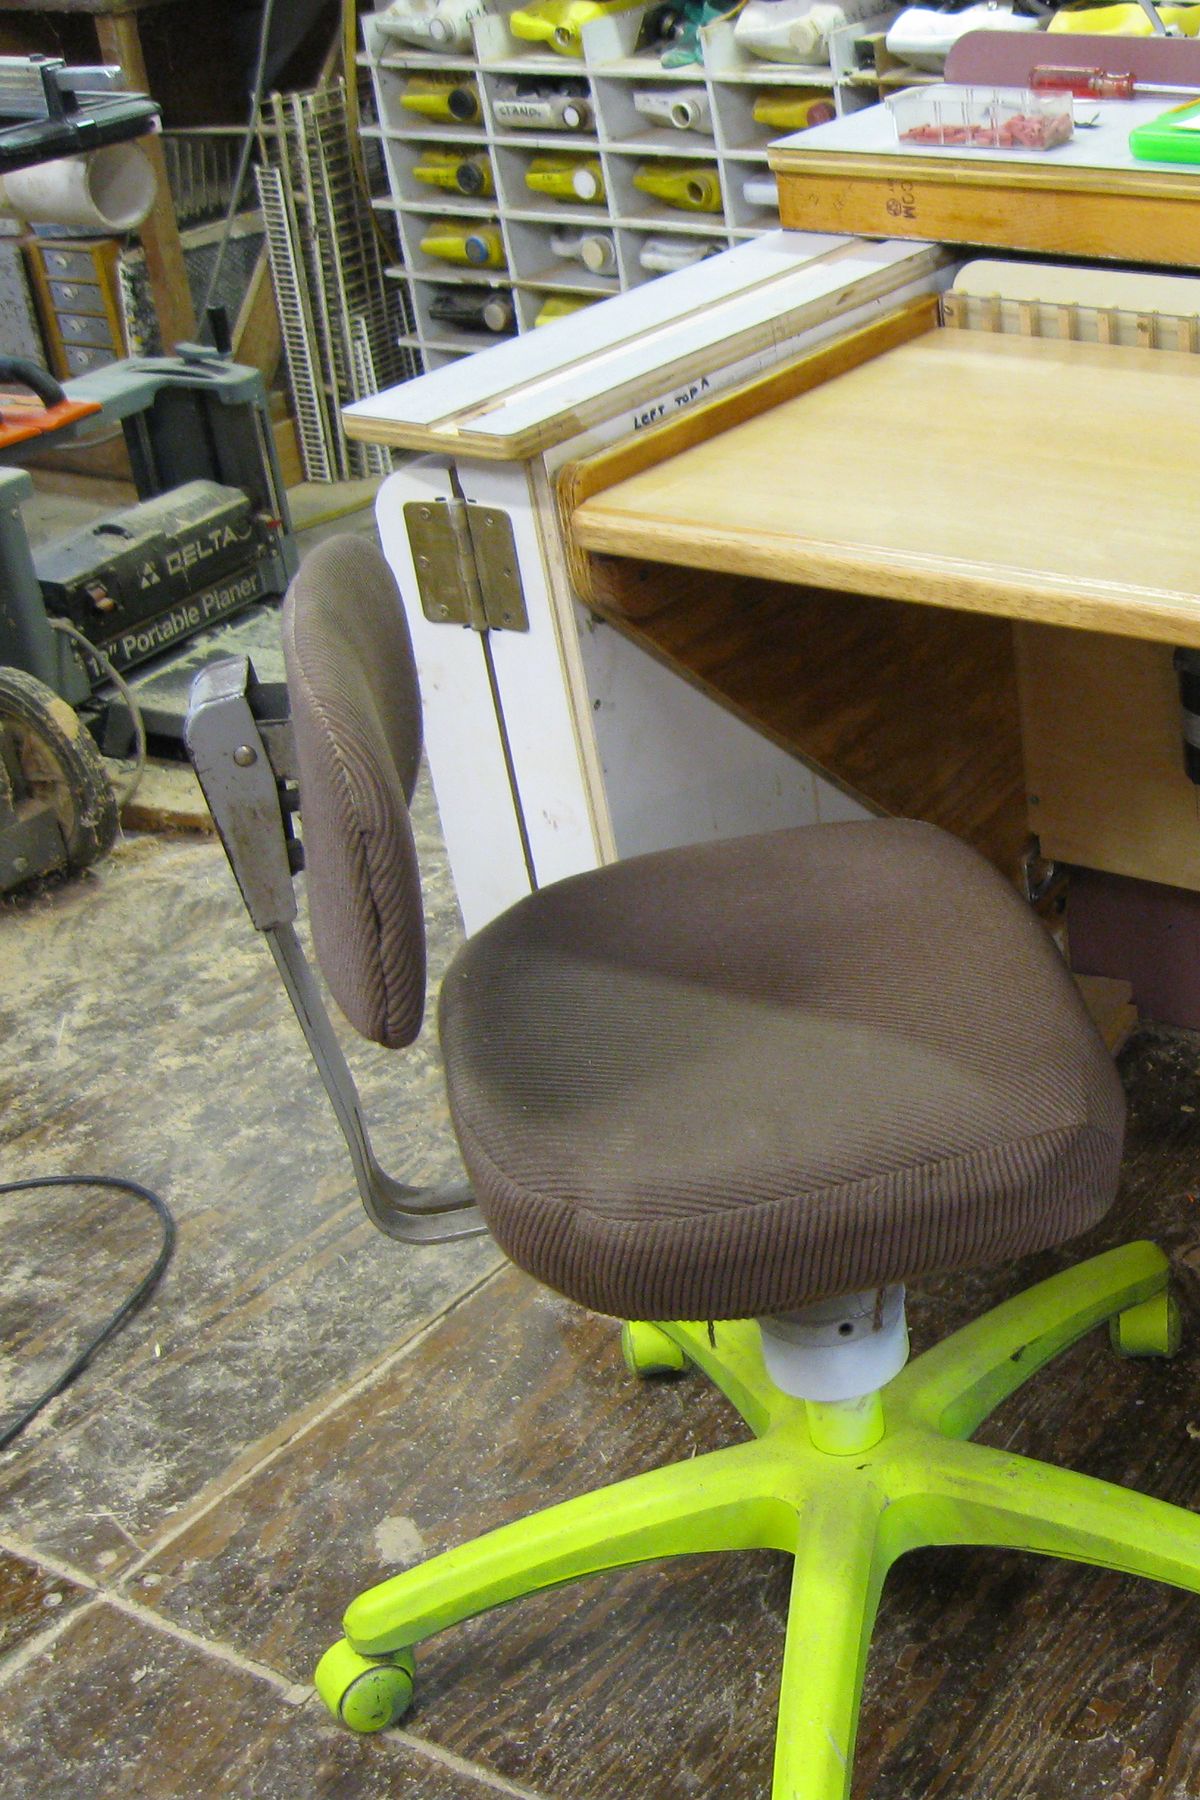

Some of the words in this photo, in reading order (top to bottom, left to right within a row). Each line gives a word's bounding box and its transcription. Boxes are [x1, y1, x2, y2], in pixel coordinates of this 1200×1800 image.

[633, 405, 665, 430] LEFT
[675, 387, 698, 406] TOP
[166, 524, 239, 577] DELTA
[123, 603, 202, 660] Portable
[203, 572, 259, 617] Planer
